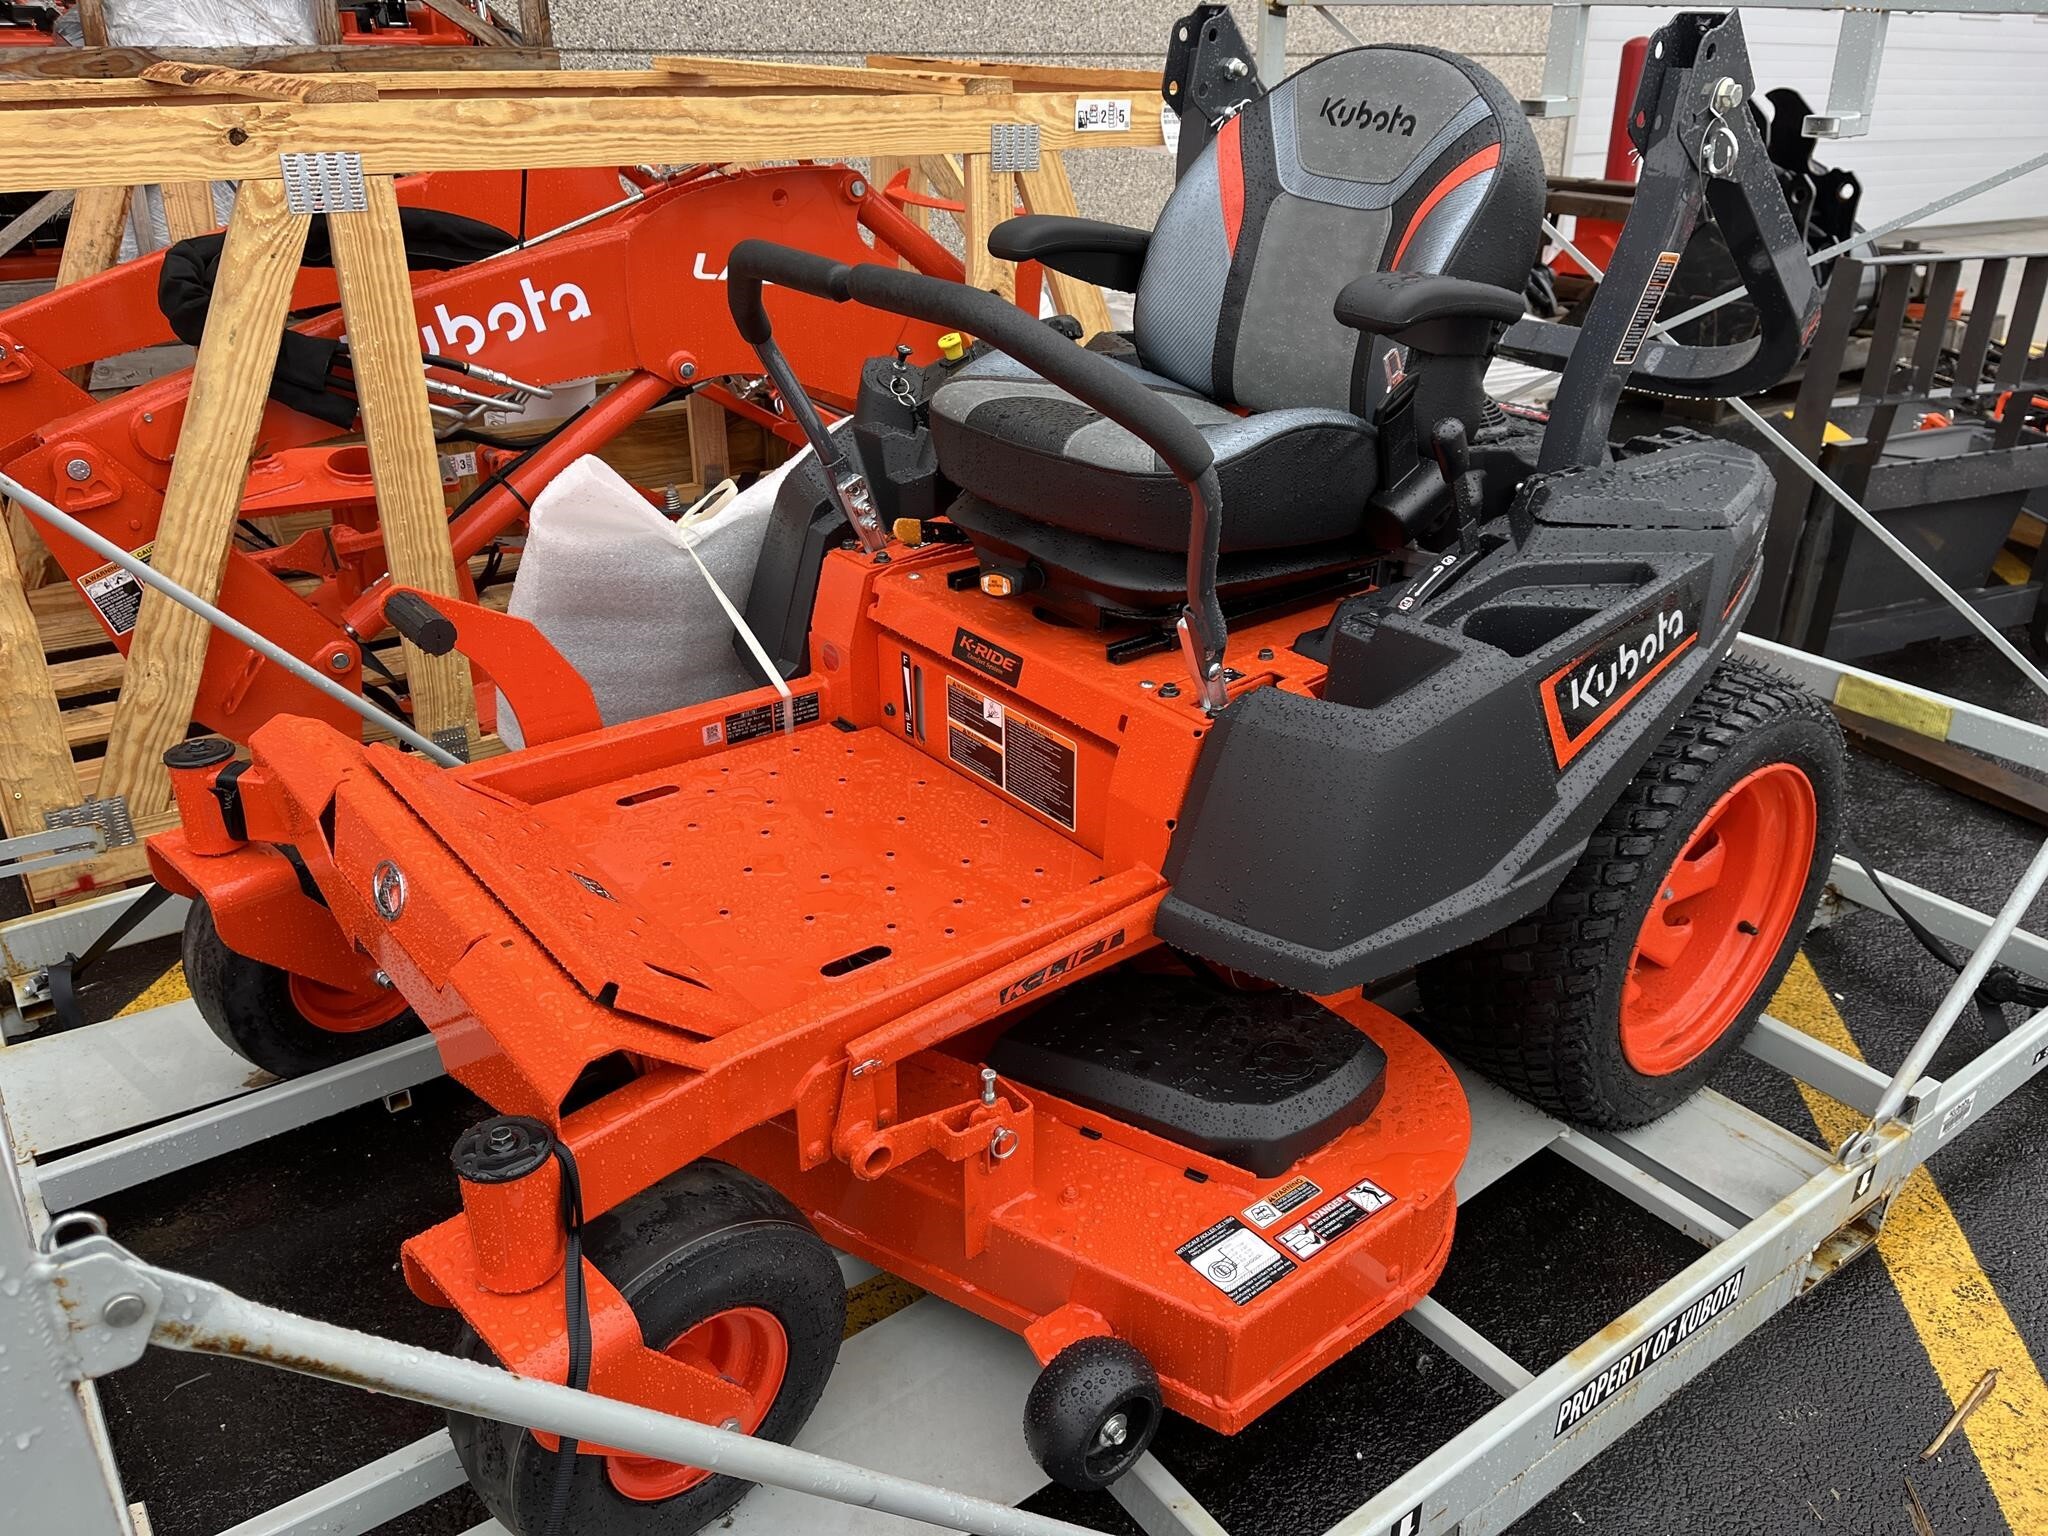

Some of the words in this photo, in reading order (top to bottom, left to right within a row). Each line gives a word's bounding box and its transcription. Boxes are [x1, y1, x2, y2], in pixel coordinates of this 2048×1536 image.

[1101, 110, 1107, 123] 2
[1119, 110, 1125, 123] 5
[1319, 97, 1417, 137] Kubota
[420, 278, 592, 369] ubota
[459, 459, 466, 470] 3
[903, 655, 909, 665] F
[959, 635, 1017, 673] K-RIDE
[1570, 609, 1684, 710] Kubota
[906, 722, 912, 733] E
[1003, 930, 1121, 1004] K-LIFT
[1273, 1178, 1304, 1199] WARNING
[1312, 1196, 1347, 1220] DANGER
[1556, 1337, 1654, 1435] PROPERTY
[1652, 1321, 1678, 1360] OF
[1676, 1271, 1743, 1343] KUBOTA
